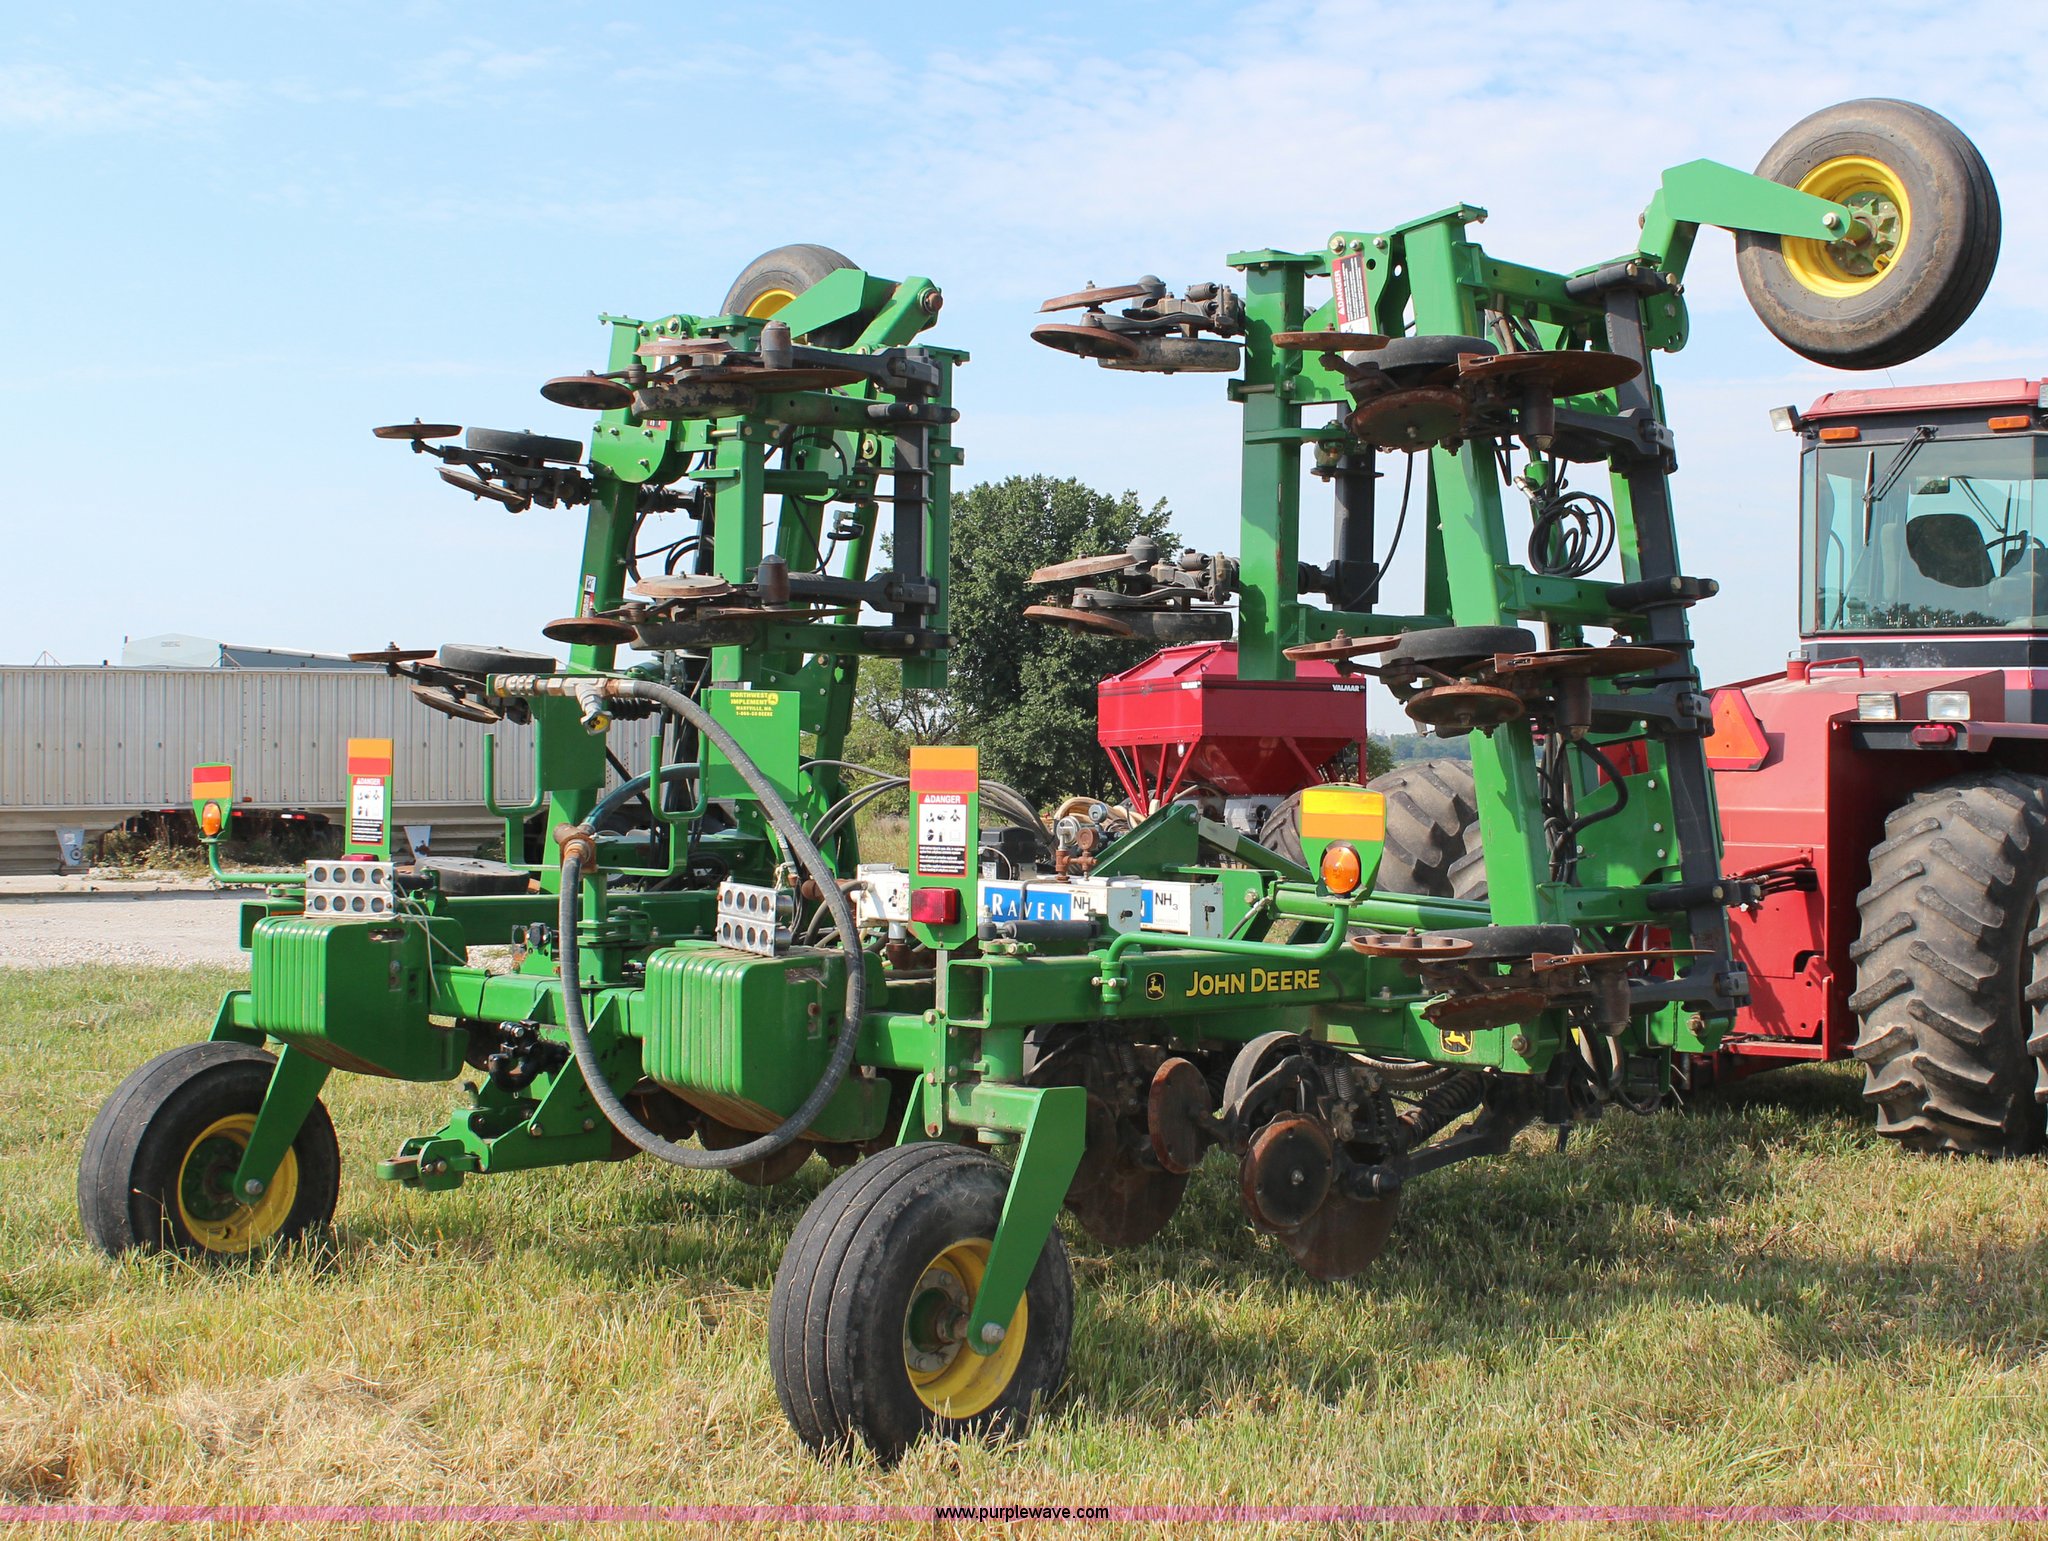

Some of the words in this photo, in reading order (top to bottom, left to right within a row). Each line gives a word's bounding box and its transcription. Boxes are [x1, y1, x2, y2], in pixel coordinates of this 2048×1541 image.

[1334, 270, 1345, 308] DANGER
[1332, 684, 1360, 692] VALMAR
[930, 795, 961, 804] DANGER
[992, 893, 1063, 921] RAVEN
[1186, 971, 1245, 997] JOHN
[1250, 967, 1320, 993] DEERE
